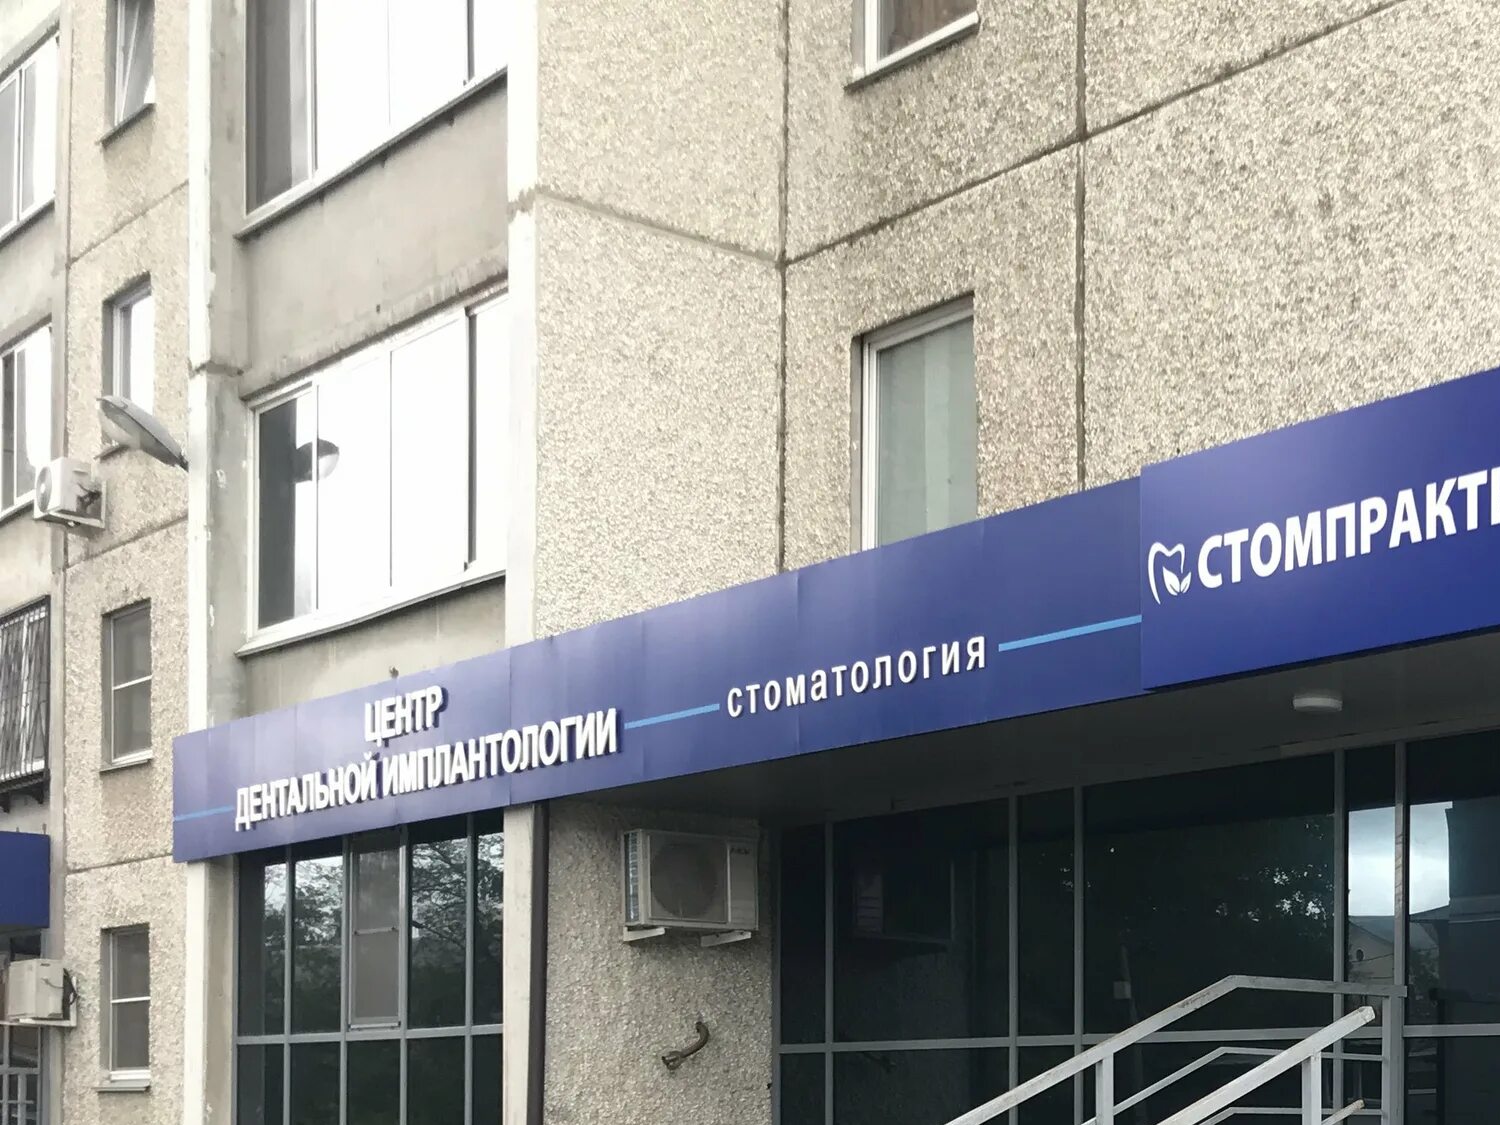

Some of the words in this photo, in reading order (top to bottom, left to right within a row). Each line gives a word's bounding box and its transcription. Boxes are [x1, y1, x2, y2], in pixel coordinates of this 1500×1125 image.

[364, 685, 445, 746] ЦЕНТР
[727, 635, 986, 719] стоматология
[234, 751, 379, 832] ДЕНТАЛЬНОЙ
[382, 707, 618, 796] ИМПЛАНТОЛОГИИ
